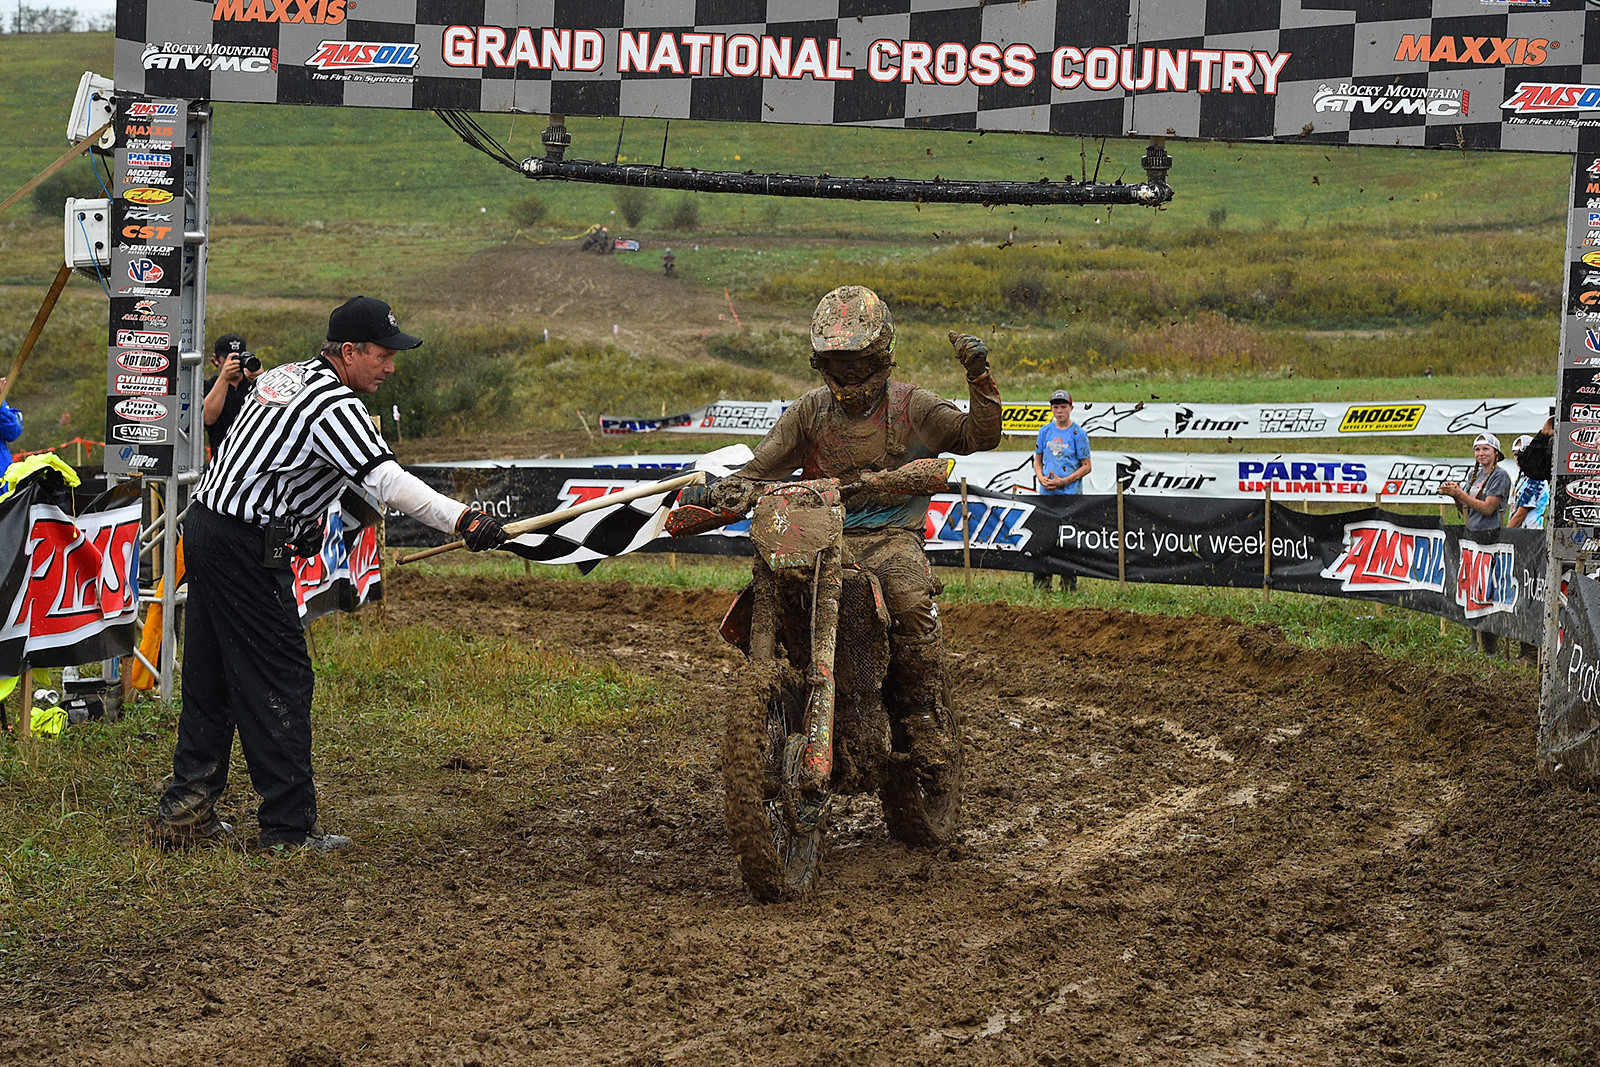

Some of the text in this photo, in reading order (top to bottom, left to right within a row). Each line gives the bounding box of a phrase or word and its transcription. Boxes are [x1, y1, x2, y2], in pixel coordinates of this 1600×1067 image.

[211, 0, 347, 25] MAXXIS
[306, 41, 419, 69] AMSOIL
[1394, 34, 1549, 66] MAXXIS
[443, 25, 1292, 95] GRAND NATIONAL CROSS COUNTRY
[330, 73, 351, 81] First
[365, 76, 414, 84] Synthetics
[127, 103, 178, 116] AMSOIL
[1508, 116, 1528, 124] The
[1529, 117, 1554, 125] First
[125, 125, 173, 136] MAXXIS
[128, 153, 171, 162] PARTS
[127, 169, 167, 178] MOOSE
[132, 177, 175, 186] RACING
[123, 190, 174, 202] FMF
[122, 225, 172, 239] CST
[129, 244, 175, 253] DUNLOP
[129, 259, 153, 282] VP
[132, 286, 173, 296] WISECO
[122, 354, 140, 366] HOT
[117, 374, 168, 386] CYLINDER
[706, 406, 768, 418] MOOSE
[1002, 408, 1053, 422] OOSE
[1347, 408, 1420, 424] MOOSE
[712, 417, 777, 429] RACING
[1191, 418, 1249, 431] thor
[120, 426, 160, 437] EVANS
[128, 454, 159, 468] HiPer
[1238, 461, 1367, 482] PARTS
[1138, 471, 1217, 490] thor
[1238, 481, 1368, 494] UNLIMITED
[1058, 524, 1145, 550] Protect
[1151, 530, 1202, 557] your
[273, 547, 283, 559] 22
[1325, 524, 1446, 590] AMSOIL
[1457, 544, 1517, 614] AMSOIL
